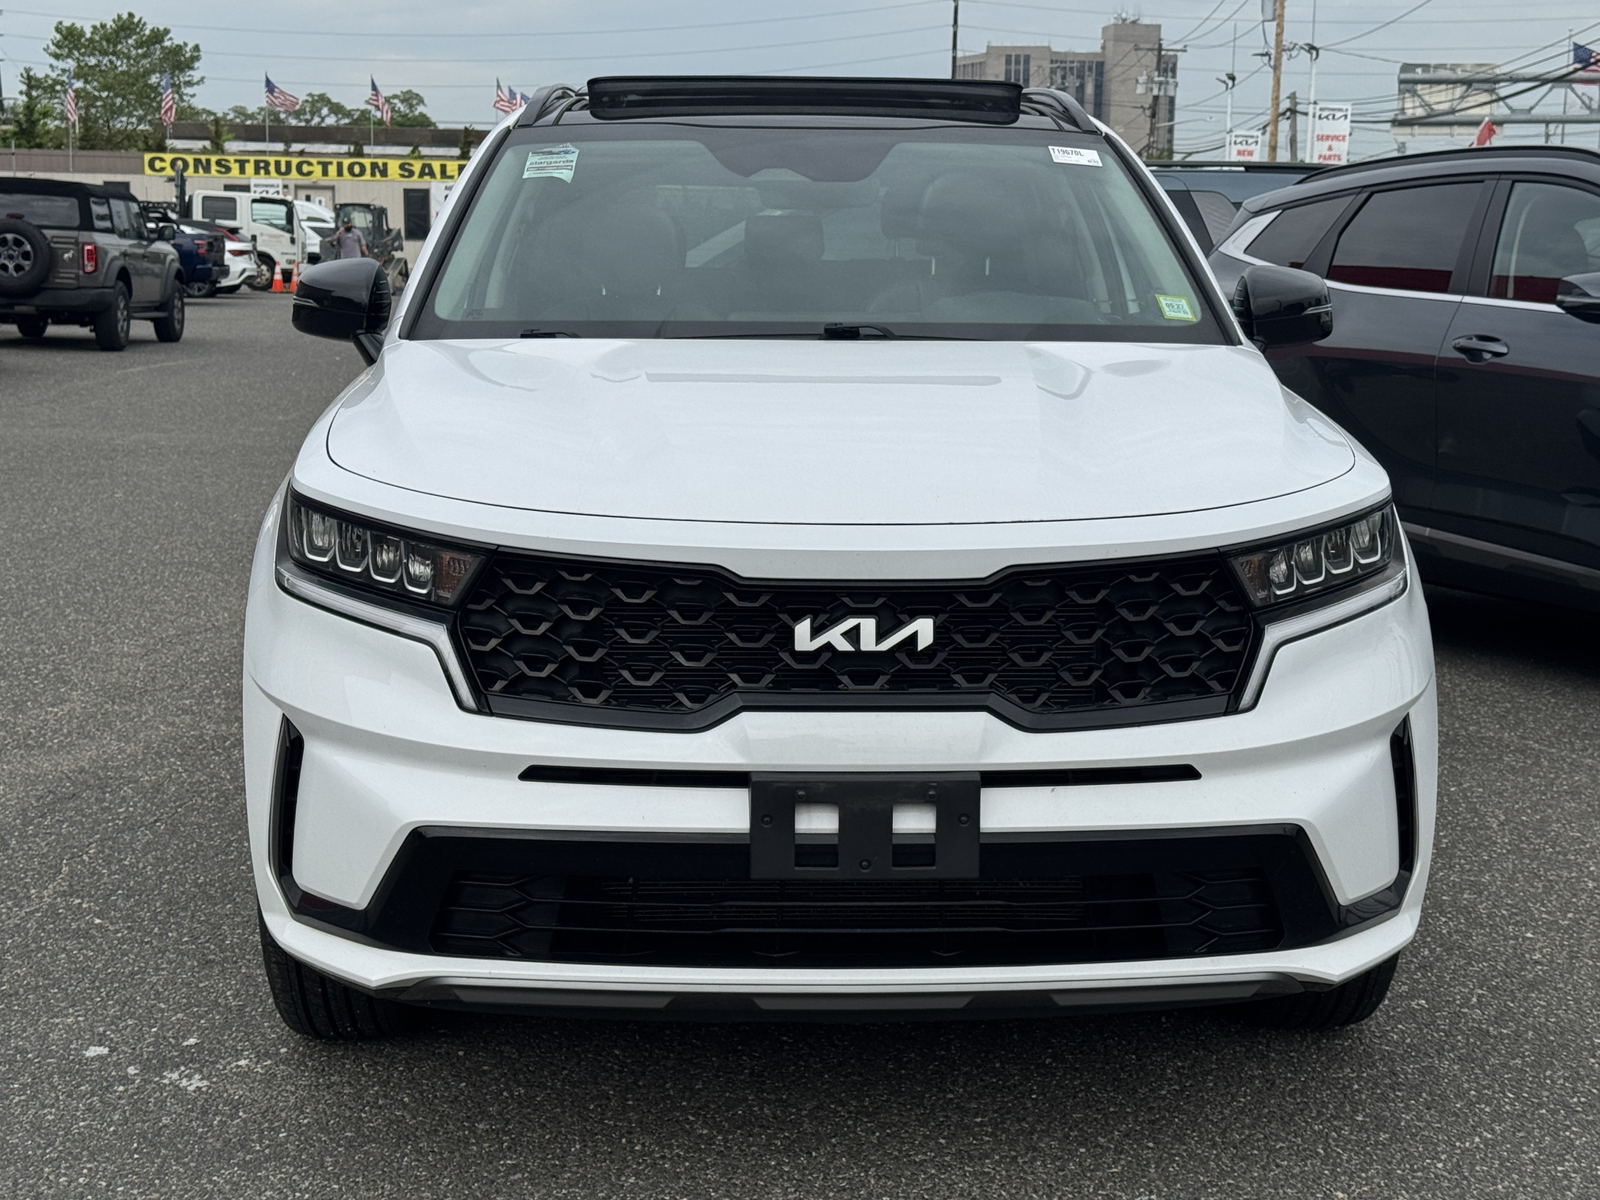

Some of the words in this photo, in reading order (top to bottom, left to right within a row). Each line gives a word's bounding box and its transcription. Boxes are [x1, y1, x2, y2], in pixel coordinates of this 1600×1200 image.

[1316, 134, 1347, 142] SERVICE
[1318, 153, 1342, 162] PARTS
[148, 156, 389, 178] CONSTRUCTION
[794, 616, 935, 652] KIA
